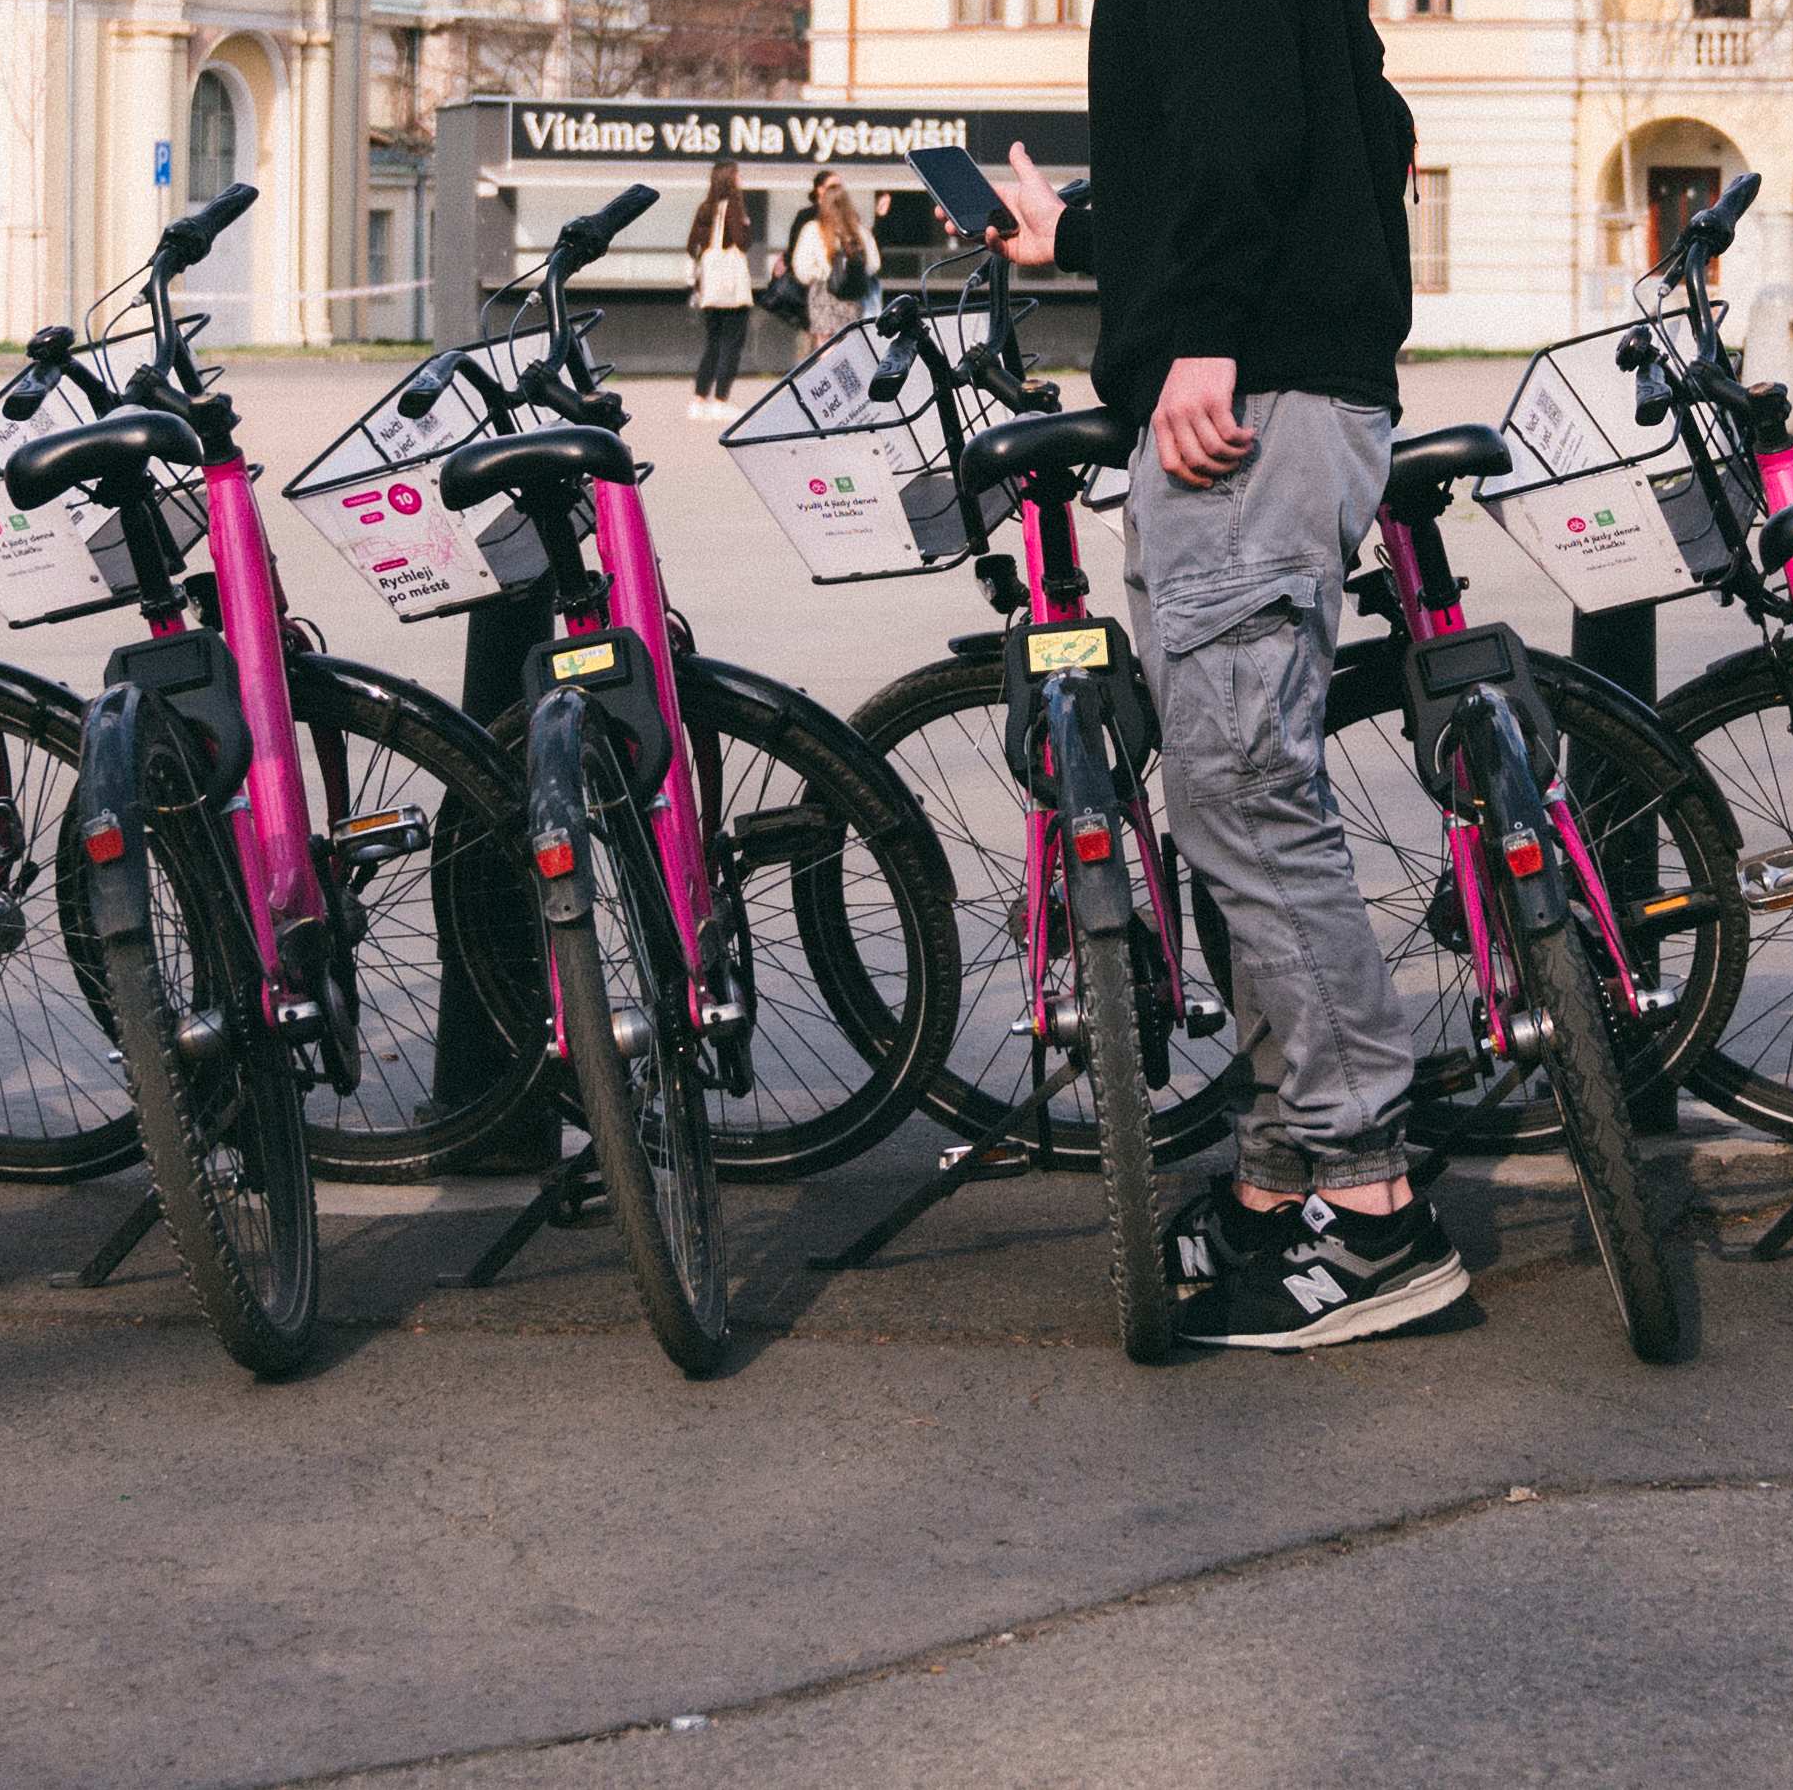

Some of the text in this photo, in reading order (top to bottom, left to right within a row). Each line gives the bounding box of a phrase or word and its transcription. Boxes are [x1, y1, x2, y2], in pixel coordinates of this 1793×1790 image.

[523, 112, 967, 162] Vítáme vás Na Výstavišti
[395, 492, 414, 507] 10
[379, 565, 434, 591] Rychleji
[388, 579, 451, 606] po městě
[1177, 1235, 1217, 1278] N
[1282, 1266, 1348, 1314] N
